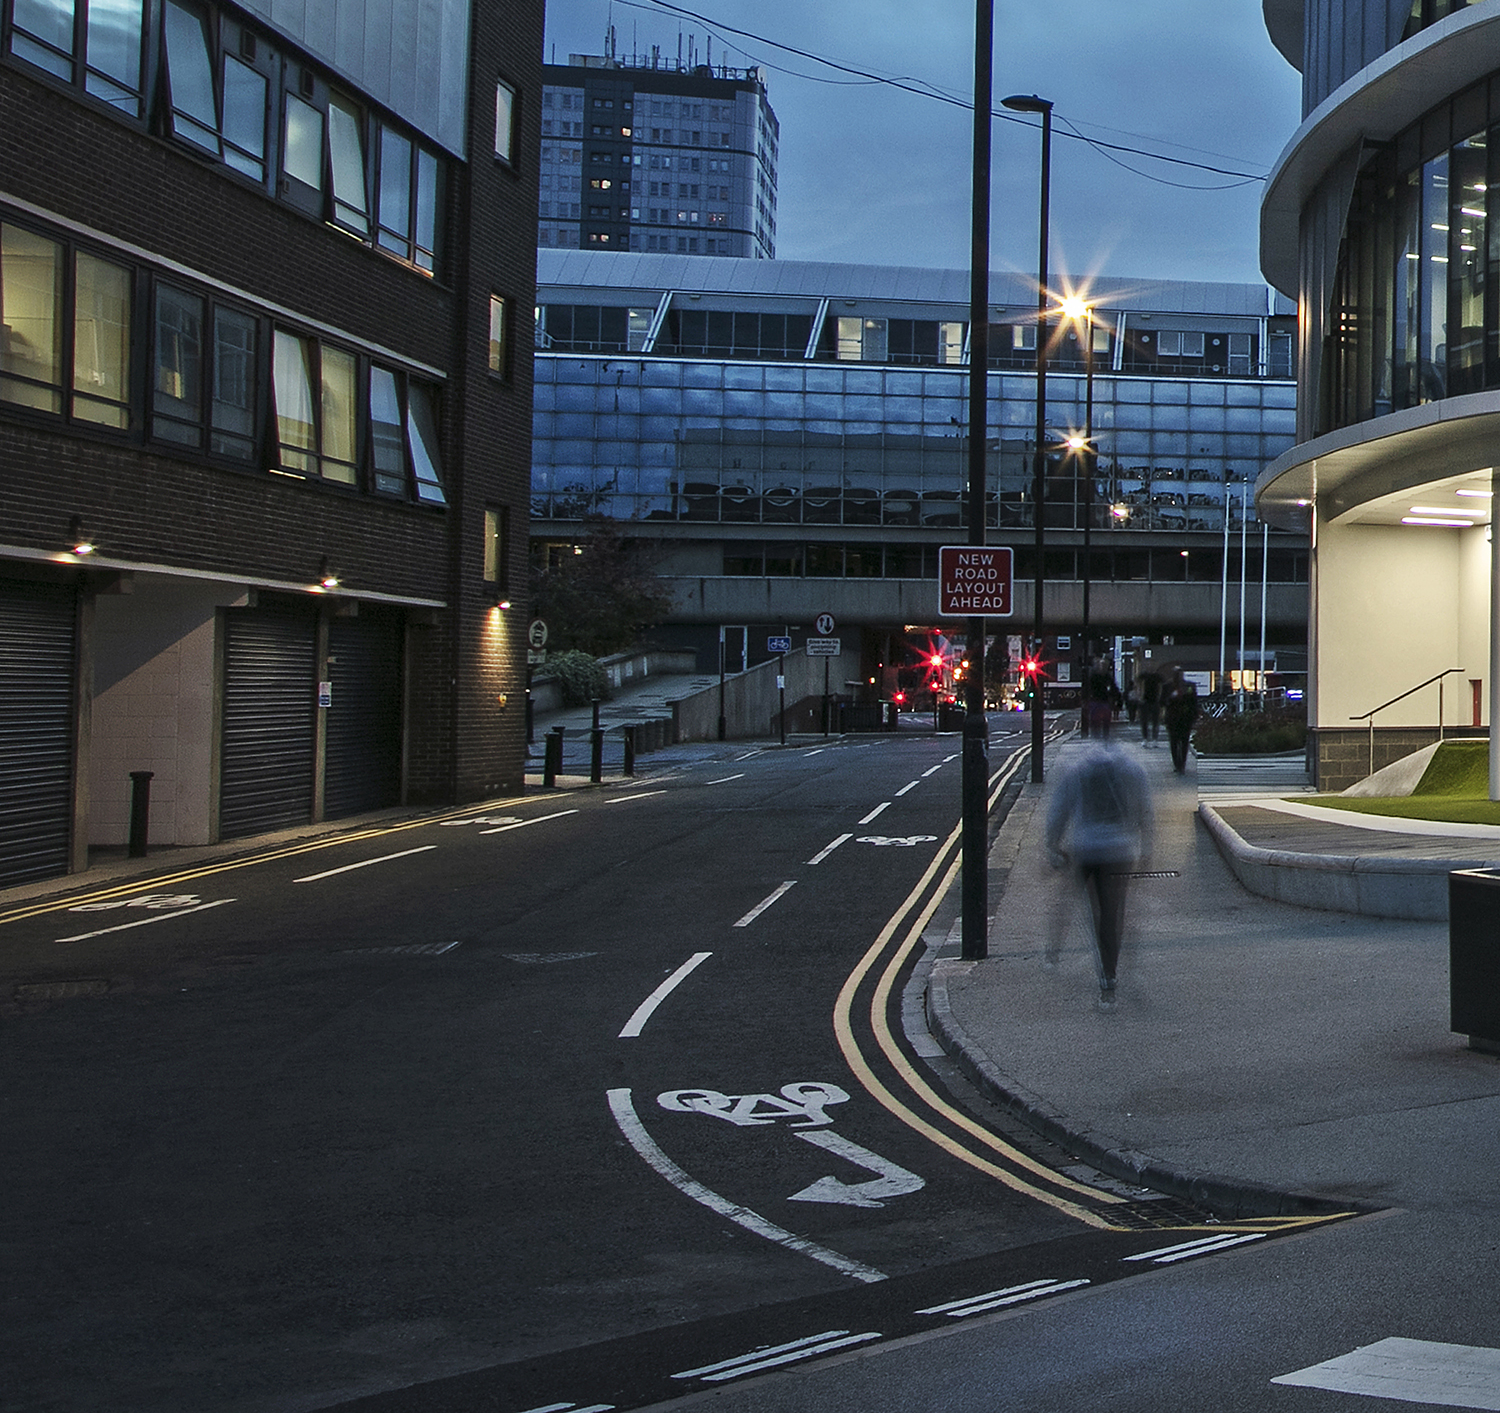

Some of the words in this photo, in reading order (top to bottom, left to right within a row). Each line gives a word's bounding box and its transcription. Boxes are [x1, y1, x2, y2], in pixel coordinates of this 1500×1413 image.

[958, 554, 994, 565] NEW
[955, 568, 998, 579] ROAD
[946, 582, 1005, 594] LAYOUT
[949, 597, 1003, 608] AHEAD
